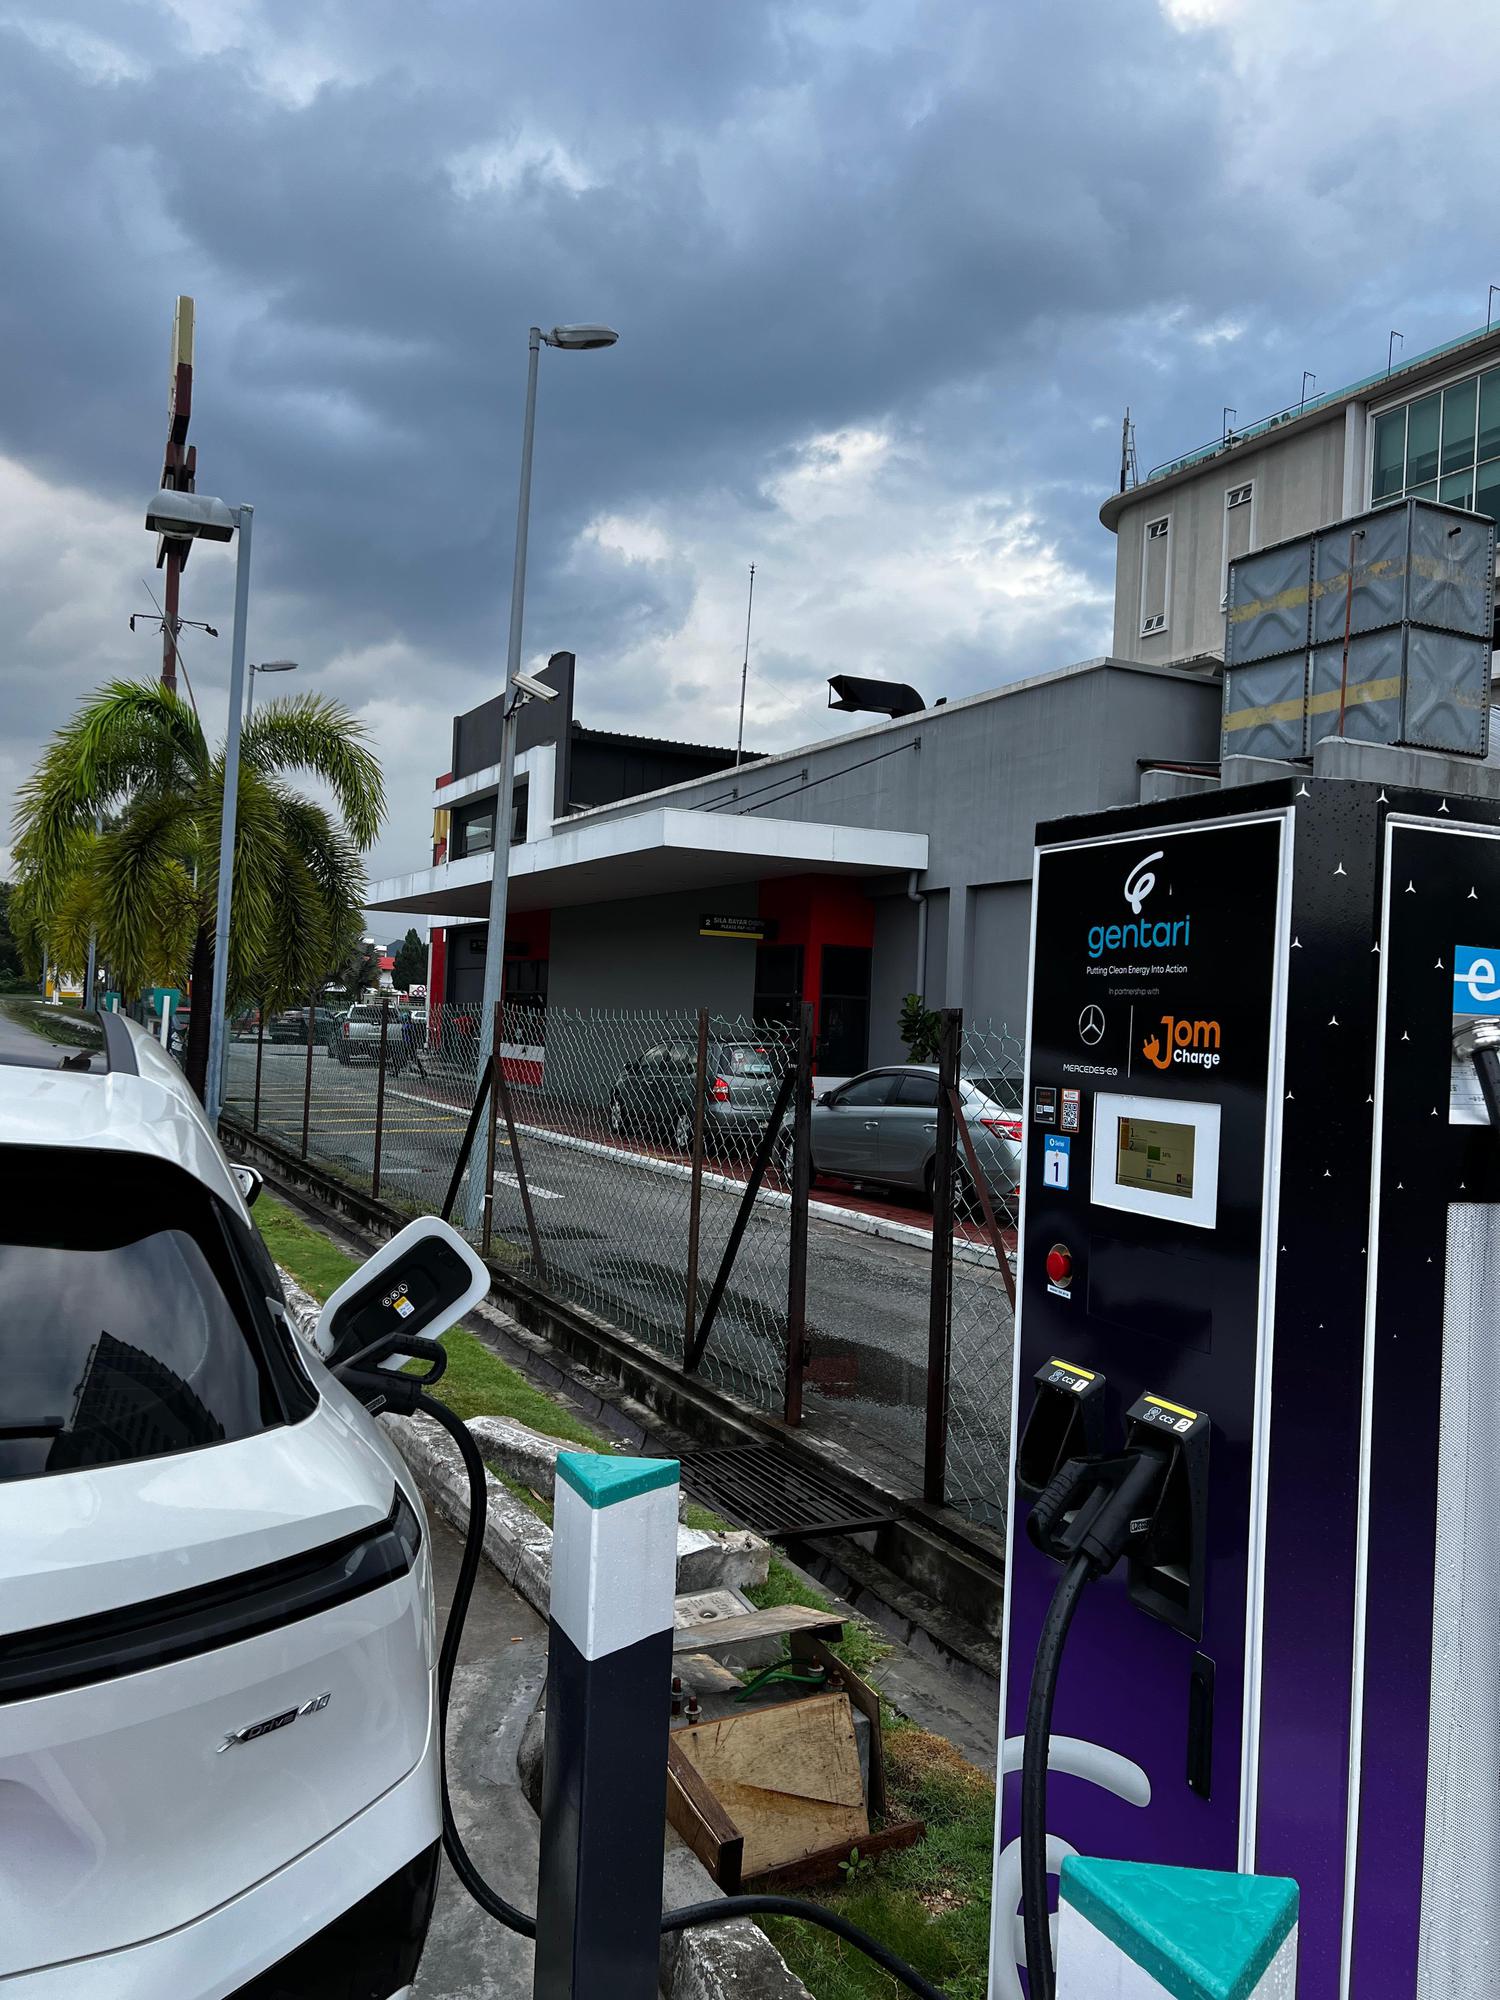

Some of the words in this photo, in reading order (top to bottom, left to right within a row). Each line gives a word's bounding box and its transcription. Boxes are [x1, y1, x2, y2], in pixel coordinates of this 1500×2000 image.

[1088, 914, 1190, 958] gentari
[1086, 965, 1108, 977] Putting
[1108, 965, 1127, 975] Clean
[1128, 965, 1150, 976] Energy
[1151, 964, 1164, 974] Into
[1165, 964, 1188, 974] Action
[1152, 1016, 1221, 1069] Jom
[1173, 1049, 1221, 1069] Charge
[1063, 1064, 1118, 1076] MERCEDES-EQ
[1130, 1127, 1135, 1138] 1
[1129, 1140, 1135, 1151] 2
[1053, 1161, 1059, 1182] 1
[1061, 1375, 1076, 1386] CCS
[1158, 1413, 1176, 1425] CCS
